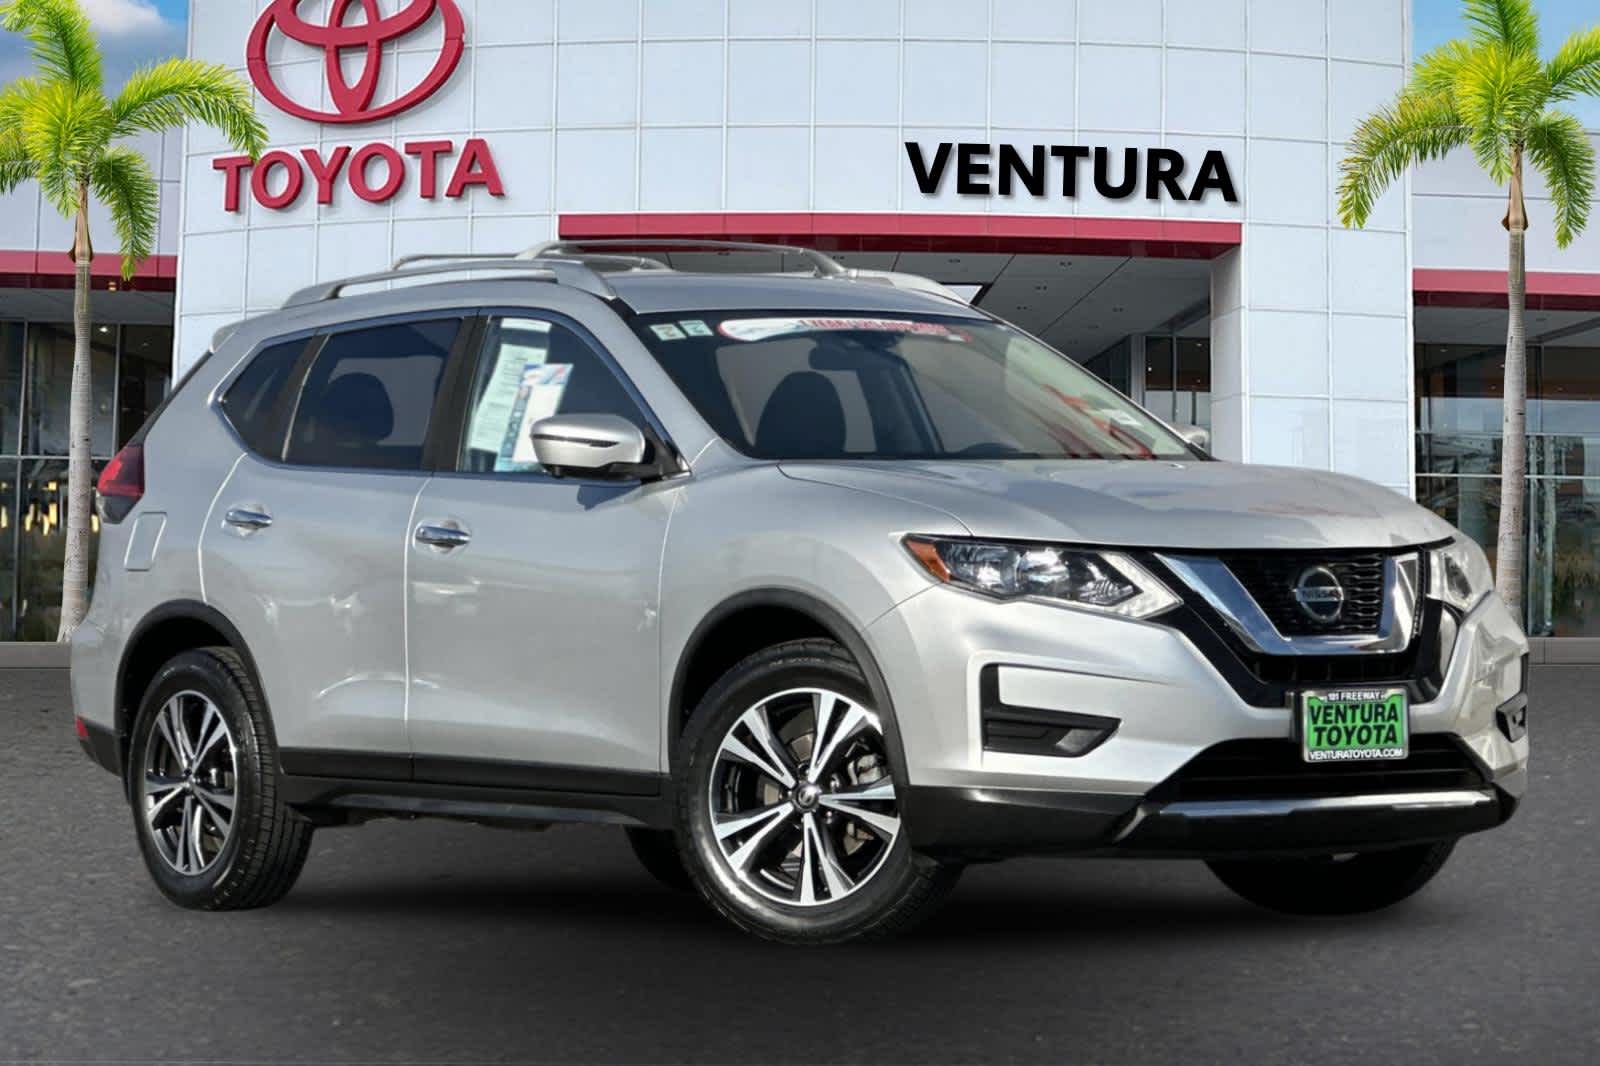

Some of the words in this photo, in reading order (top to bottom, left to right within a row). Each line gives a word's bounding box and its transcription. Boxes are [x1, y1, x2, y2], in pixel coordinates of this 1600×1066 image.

[212, 138, 505, 212] TOYOTA
[904, 141, 1238, 203] VENTURA
[1340, 691, 1381, 701] FREEWAY
[1309, 703, 1399, 725] VENTURA
[1313, 723, 1398, 747] TOYOTA
[1309, 748, 1403, 760] VENTURATOYOTA.COM
